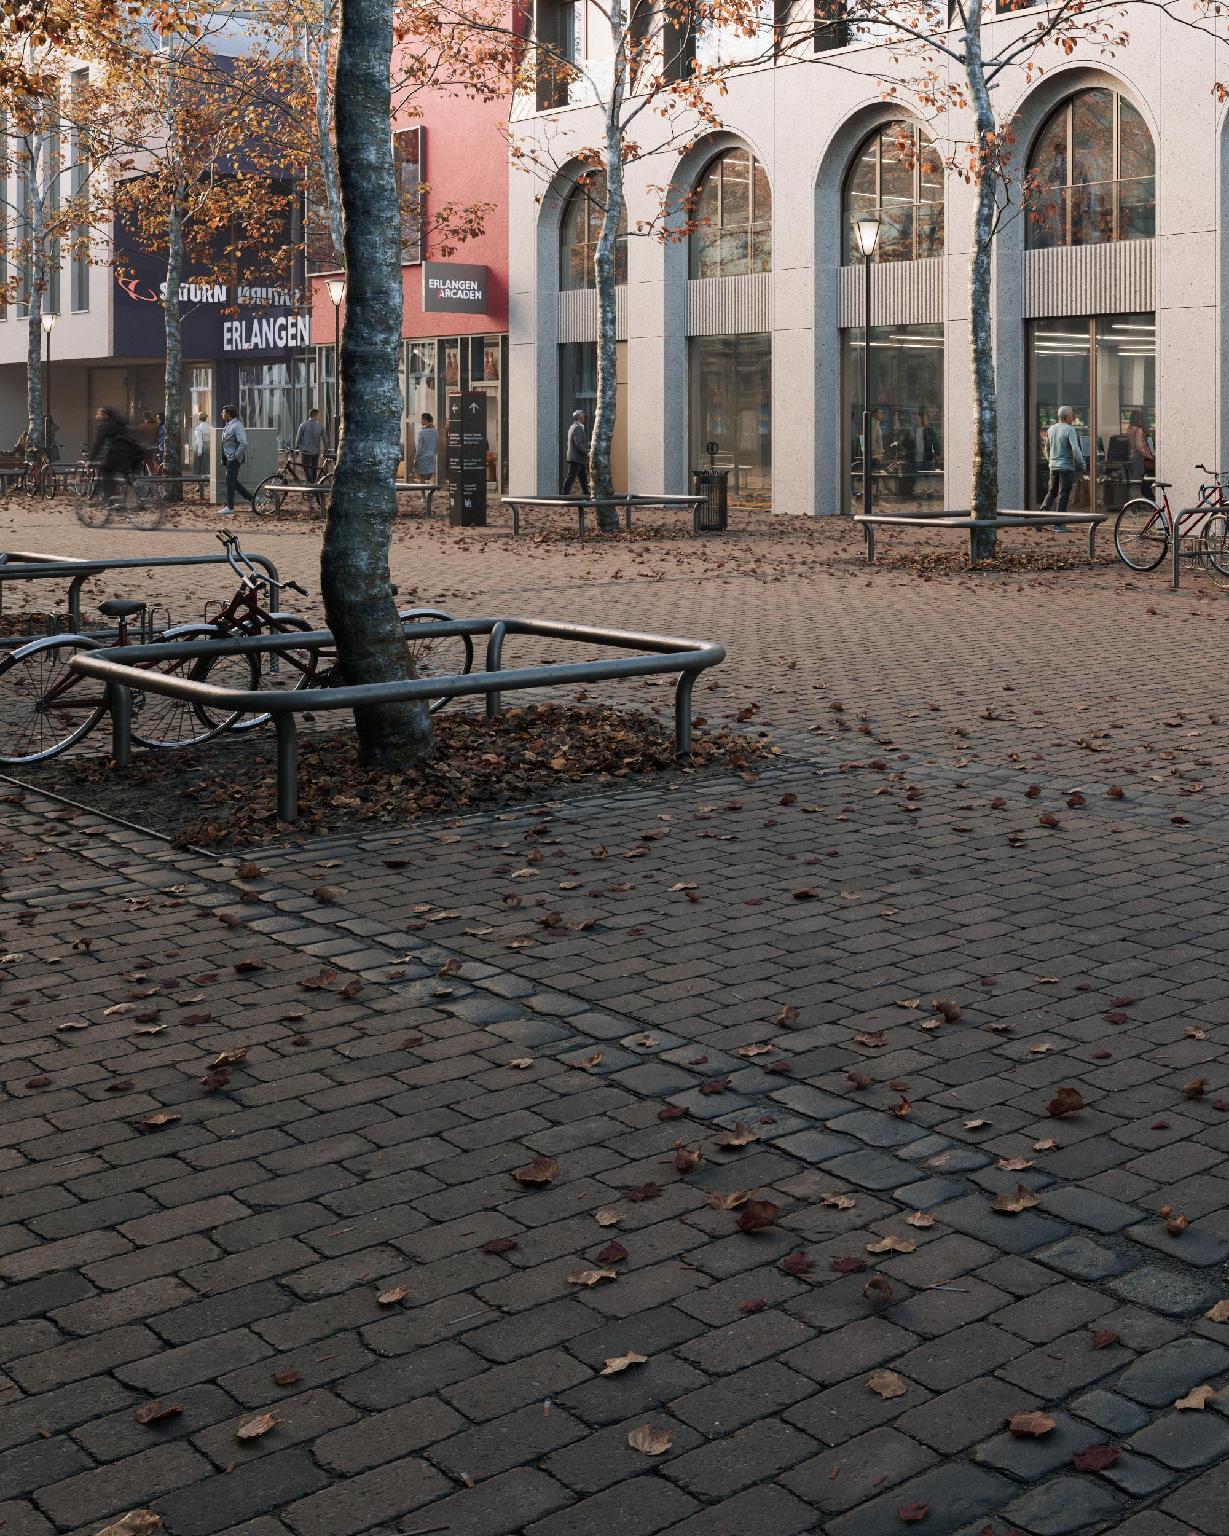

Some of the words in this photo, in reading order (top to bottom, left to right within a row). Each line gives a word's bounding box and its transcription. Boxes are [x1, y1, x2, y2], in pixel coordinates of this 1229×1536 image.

[428, 279, 478, 290] ERLANGEN
[437, 288, 482, 300] ARCADEN
[223, 315, 310, 351] ERLANGEN
